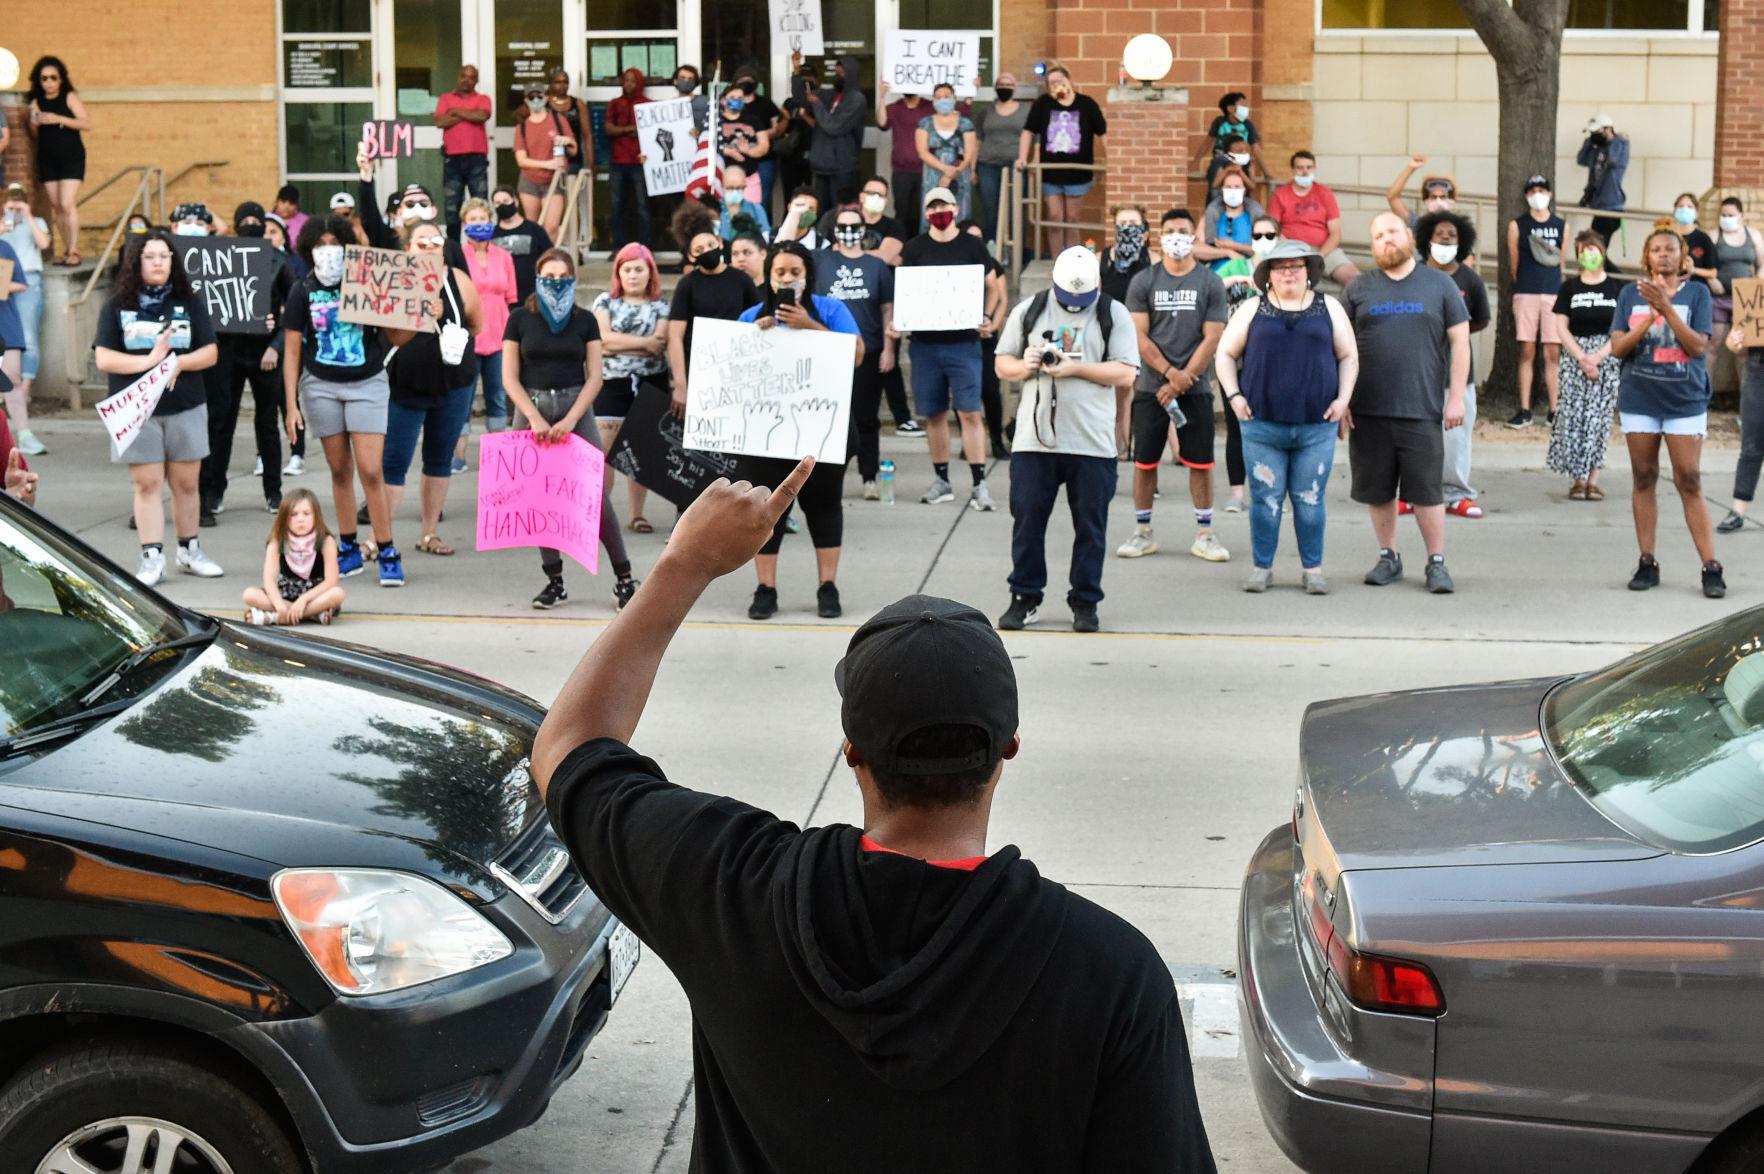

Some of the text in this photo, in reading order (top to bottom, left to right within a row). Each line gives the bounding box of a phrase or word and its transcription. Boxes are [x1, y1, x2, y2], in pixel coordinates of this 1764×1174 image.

[894, 63, 968, 86] BREATHE
[362, 120, 413, 159] BLM
[183, 245, 261, 277] CAN'T
[345, 268, 416, 291] LIVES
[343, 293, 435, 318] MATTER
[1368, 300, 1424, 316] adidas
[697, 330, 774, 371] BLACK
[496, 444, 539, 481] NO
